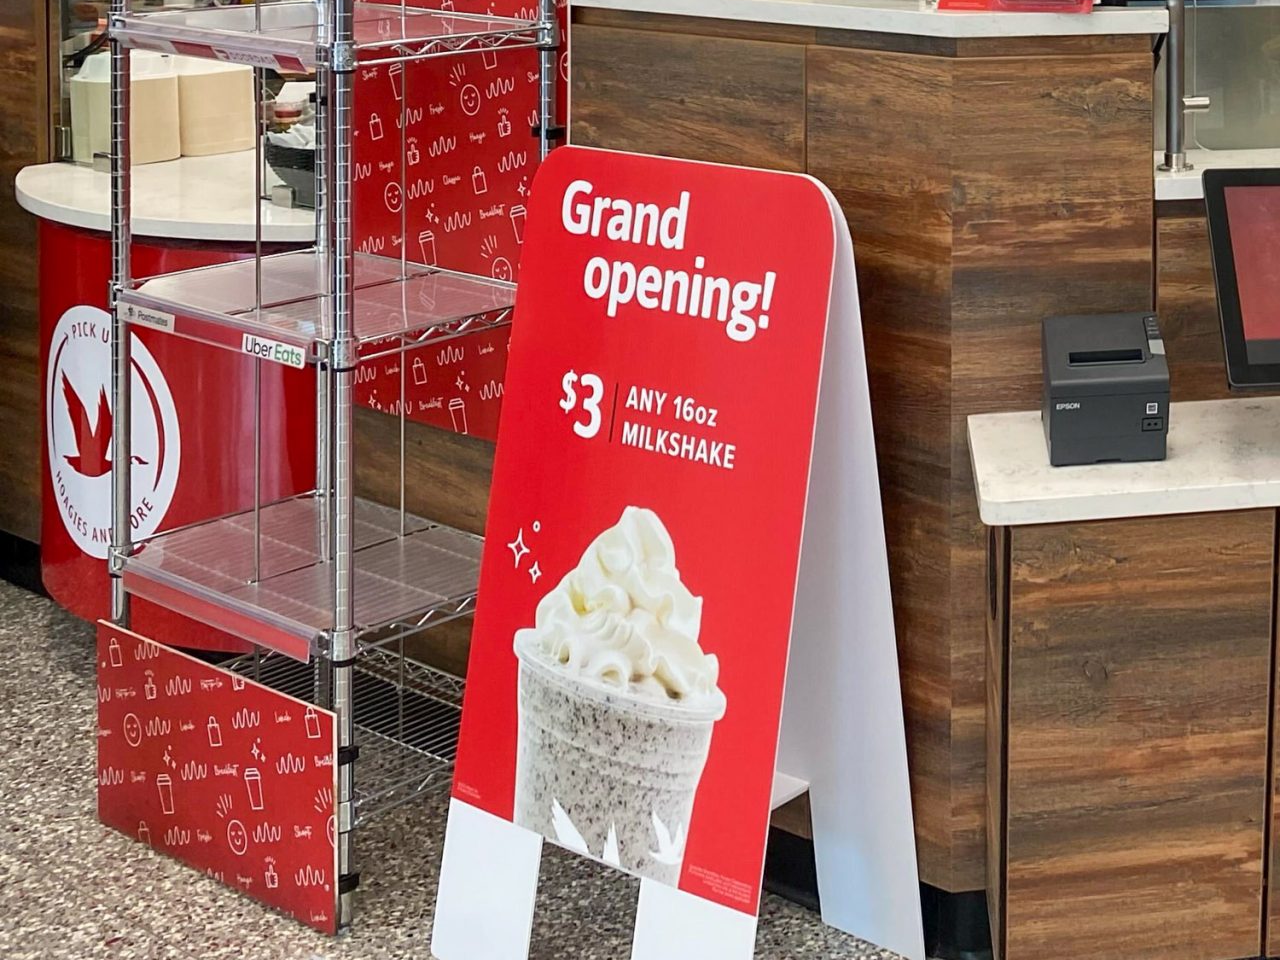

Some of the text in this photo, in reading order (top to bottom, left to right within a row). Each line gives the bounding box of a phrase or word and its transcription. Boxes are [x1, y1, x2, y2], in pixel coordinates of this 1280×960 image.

[561, 179, 691, 251] Grand
[583, 256, 776, 343] opening!
[245, 336, 301, 365] Uber Eats
[559, 369, 604, 439] $3
[625, 385, 718, 427] ANY 16oz
[1056, 402, 1080, 410] EPSON
[621, 421, 736, 469] MILKSHAKE
